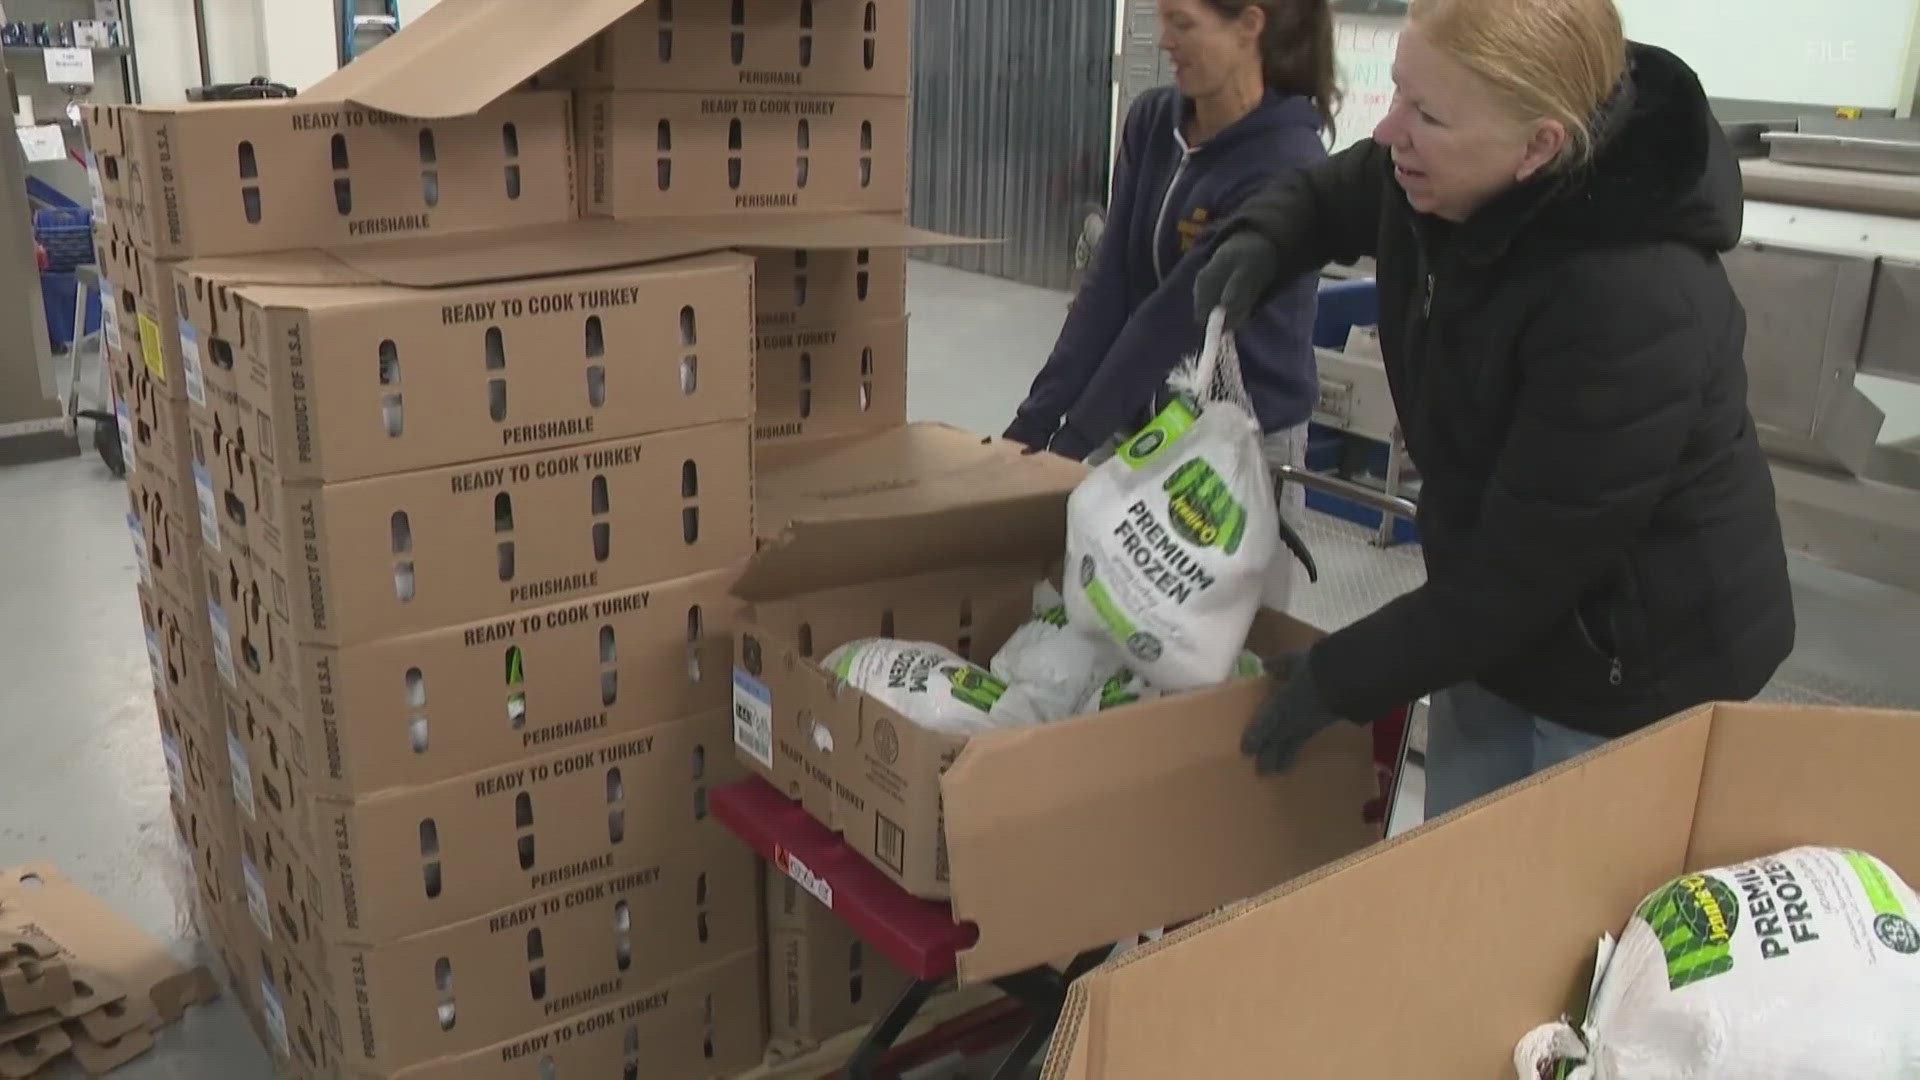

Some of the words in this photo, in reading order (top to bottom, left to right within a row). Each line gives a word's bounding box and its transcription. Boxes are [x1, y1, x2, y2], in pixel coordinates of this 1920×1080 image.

[739, 70, 802, 85] PERISHABLE
[292, 113, 340, 131] READY
[346, 110, 363, 128] TO
[701, 100, 739, 115] READY
[743, 100, 756, 114] TO
[760, 99, 791, 114] COOK
[795, 101, 835, 115] TURKEY
[160, 165, 174, 182] OF
[163, 186, 181, 244] PRODUCT
[735, 193, 798, 208] PERISHABLE
[349, 213, 430, 236] PERISHABLE
[441, 301, 497, 325] READY
[501, 299, 523, 318] TO
[528, 293, 574, 315] COOK
[578, 287, 640, 310] TURKEY
[763, 334, 793, 349] COOK
[797, 330, 837, 346] TURKEY
[291, 370, 306, 391] OF
[293, 393, 312, 463] PRODUCT
[503, 416, 594, 445] PERISHABLE
[756, 423, 802, 440] RISHABLE
[451, 468, 505, 494] READY
[509, 464, 530, 483] TO
[535, 456, 580, 479] COOK
[583, 445, 642, 470] TURKEY
[304, 543, 319, 564] OF
[1114, 519, 1192, 605] FROZEN
[1128, 499, 1215, 591] PREMIUM
[307, 565, 326, 630] PRODUCT
[510, 571, 598, 602] PERISHABLE
[463, 620, 516, 647] READY
[520, 616, 541, 634] TO
[546, 607, 589, 629] COOK
[592, 591, 650, 618] TURKEY
[321, 698, 335, 715] OF
[522, 712, 608, 747] PERISHABLE
[323, 717, 342, 779] PRODUCT
[475, 771, 525, 798] READY
[529, 764, 548, 784] TO
[553, 752, 595, 778] COOK
[597, 736, 654, 765] TURKEY
[531, 853, 614, 890] PERISHABLE
[488, 906, 538, 934] READY
[541, 897, 560, 917] TO
[565, 885, 605, 909] COOK
[608, 866, 661, 896] TURKEY
[544, 977, 623, 1017] PERISHABLE
[501, 1033, 550, 1063] READY
[553, 1026, 572, 1046] TO
[576, 1010, 616, 1037] COOK
[618, 990, 670, 1021] TURKEY
